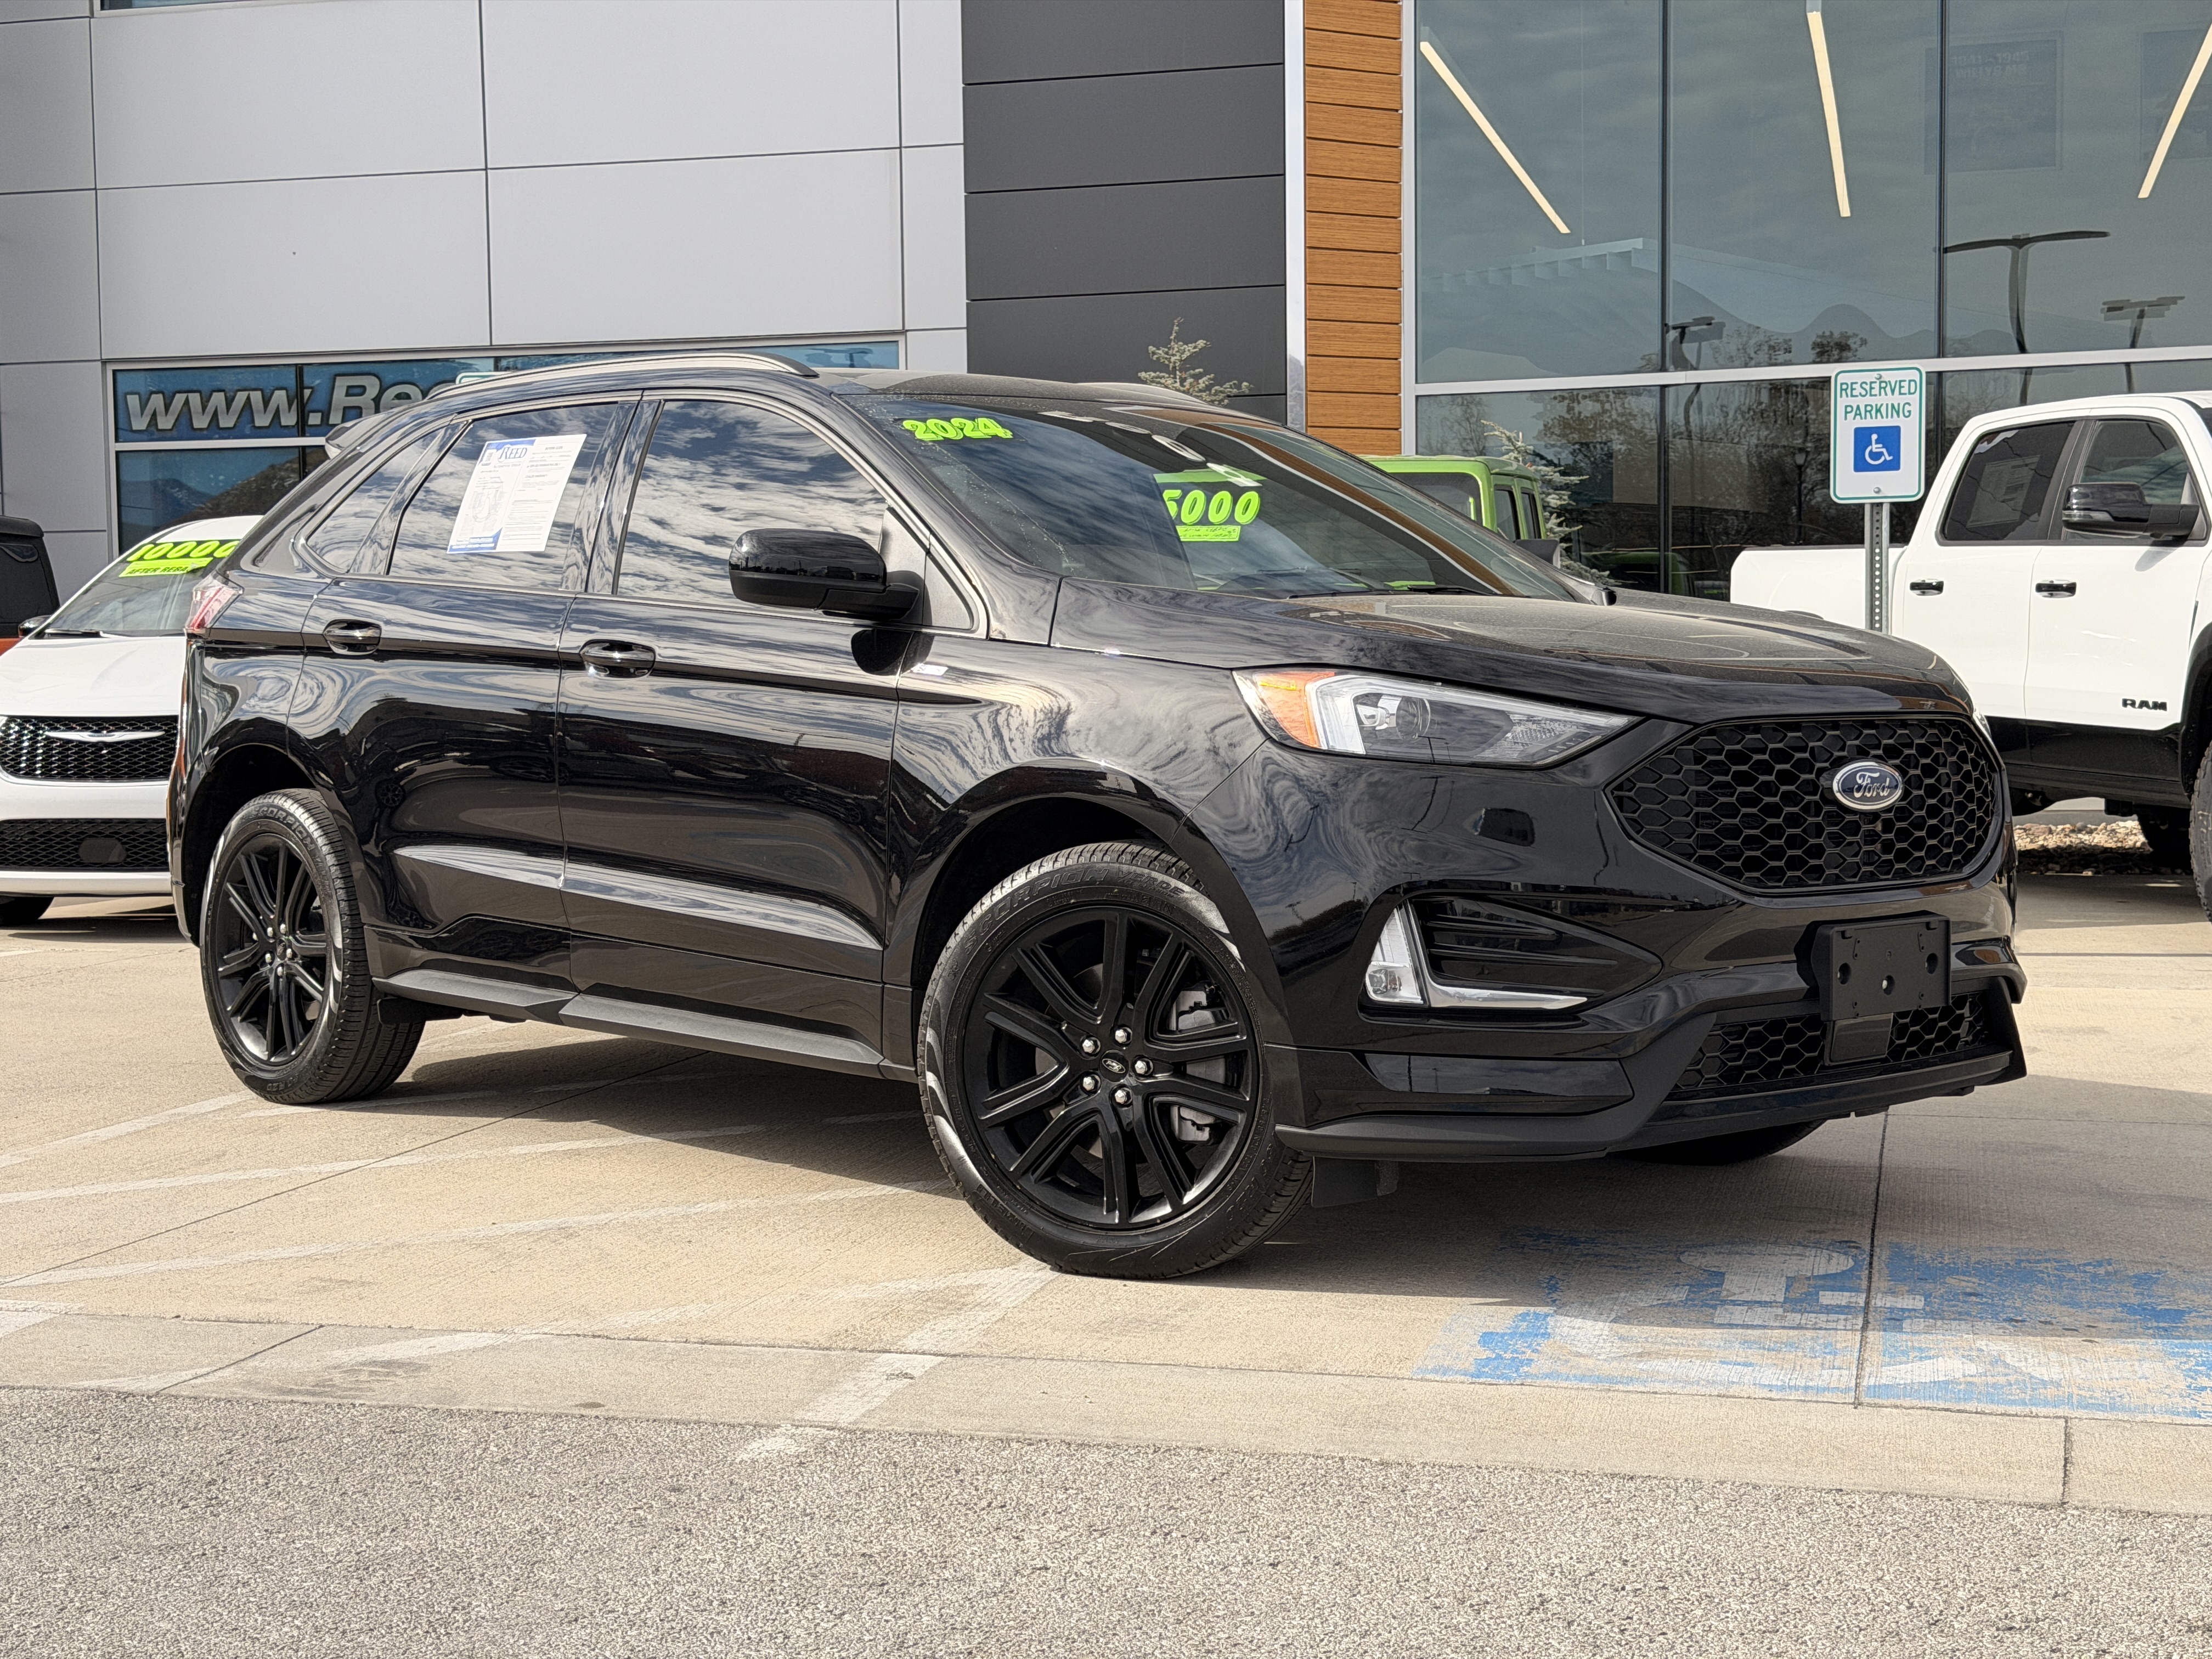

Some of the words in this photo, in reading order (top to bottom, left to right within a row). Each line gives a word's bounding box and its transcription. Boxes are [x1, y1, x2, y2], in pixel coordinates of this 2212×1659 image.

[1839, 379, 1918, 398] RESERVED
[127, 375, 456, 430] www.Re
[1844, 402, 1912, 421] PARKING
[902, 417, 1013, 441] 2024
[499, 447, 527, 460] REED
[2121, 698, 2167, 712] RAM
[1853, 771, 1890, 798] Ford
[1117, 870, 1186, 898] VERDE
[963, 868, 1109, 955] SCORPION
